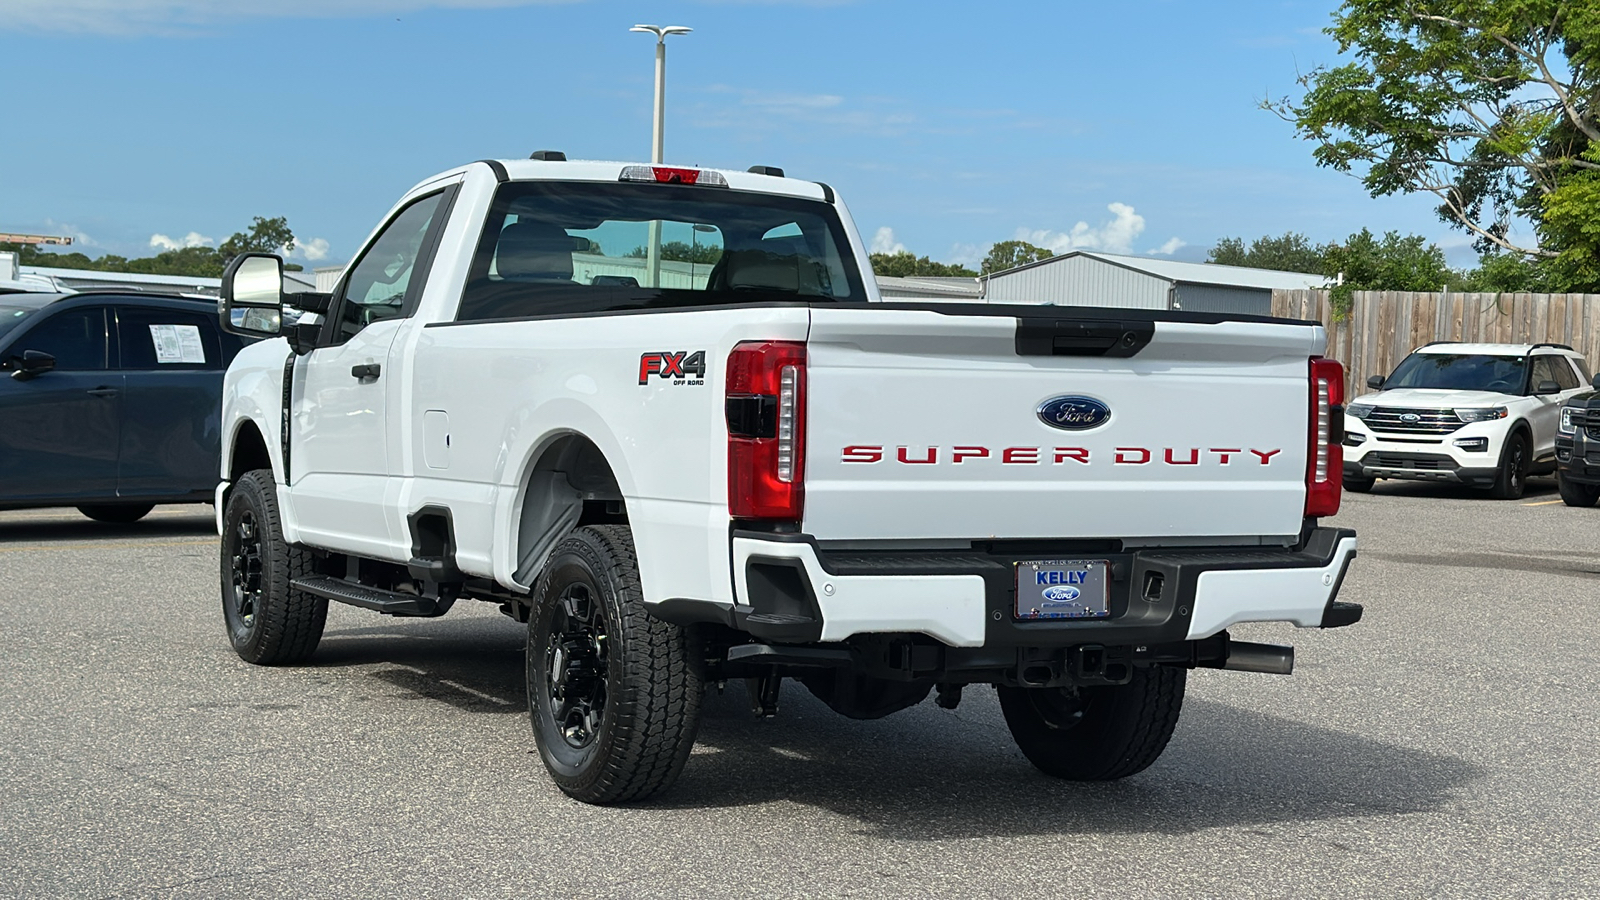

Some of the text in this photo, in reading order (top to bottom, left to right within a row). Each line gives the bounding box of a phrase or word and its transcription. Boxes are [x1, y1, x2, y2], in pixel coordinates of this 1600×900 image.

[638, 350, 706, 386] FX4
[1056, 402, 1096, 422] Ford
[841, 445, 1282, 466] SUPER DUTY
[1035, 571, 1088, 585] KELLY
[1050, 588, 1074, 600] Ford
